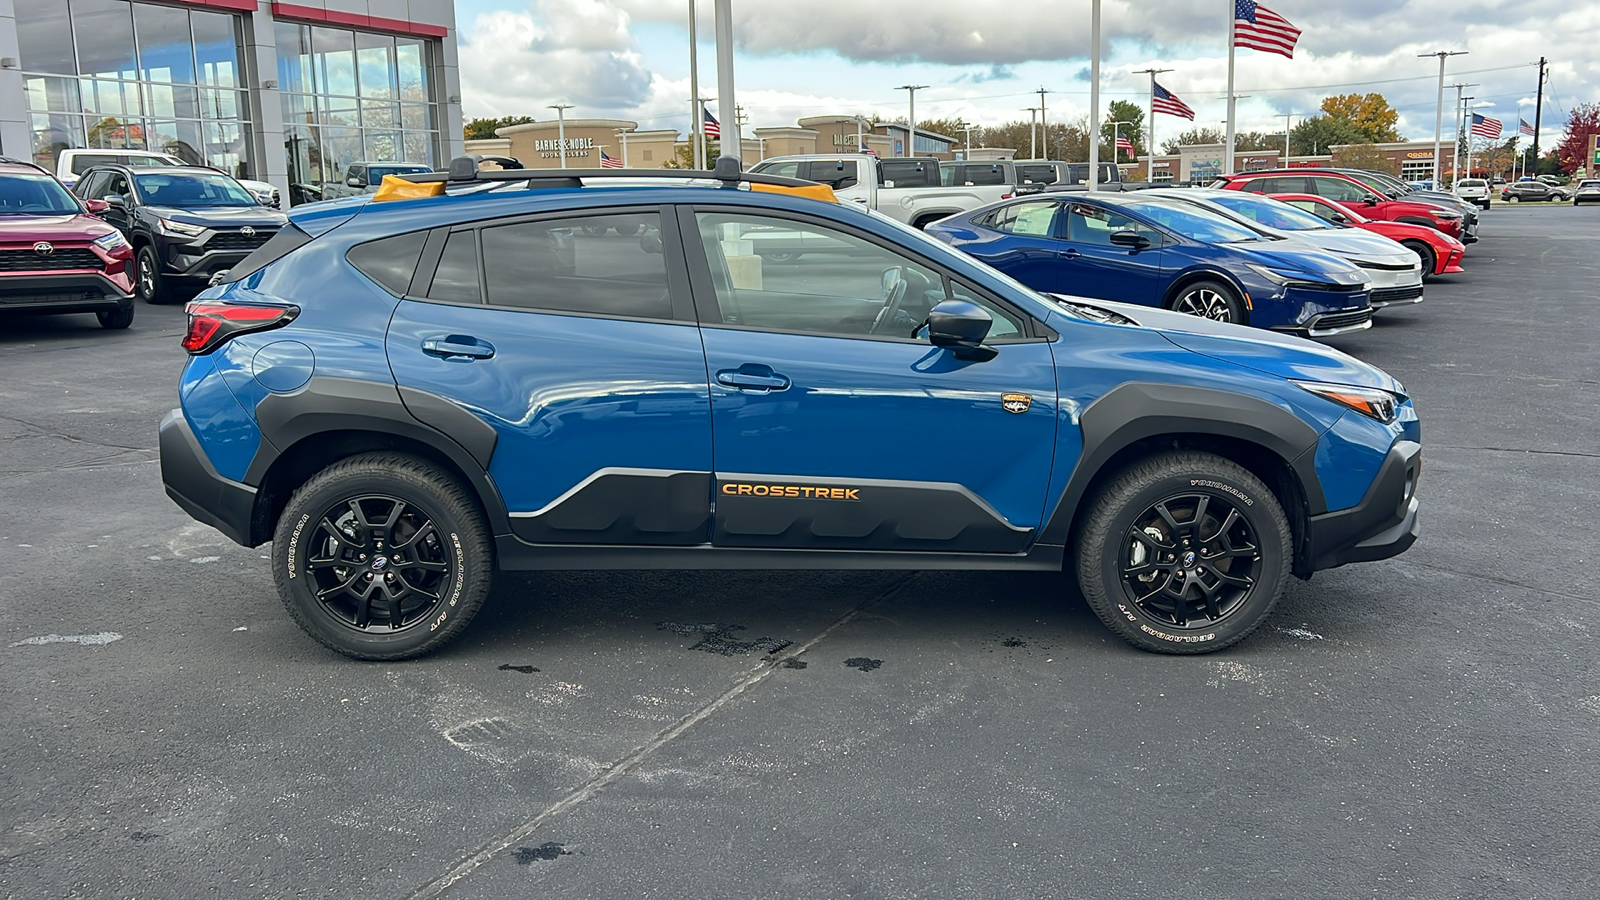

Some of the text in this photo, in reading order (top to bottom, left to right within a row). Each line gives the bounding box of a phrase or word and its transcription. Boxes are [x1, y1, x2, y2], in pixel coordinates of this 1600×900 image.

[535, 139, 562, 151] BARNES
[570, 137, 593, 149] NOBLE
[722, 483, 860, 500] CROSSTREK
[1190, 479, 1254, 507] YOKOHAMA
[287, 513, 310, 579] YOKOHAMA
[450, 532, 465, 607] GEOLANDAR
[1140, 623, 1216, 643] GEOLANDAR
